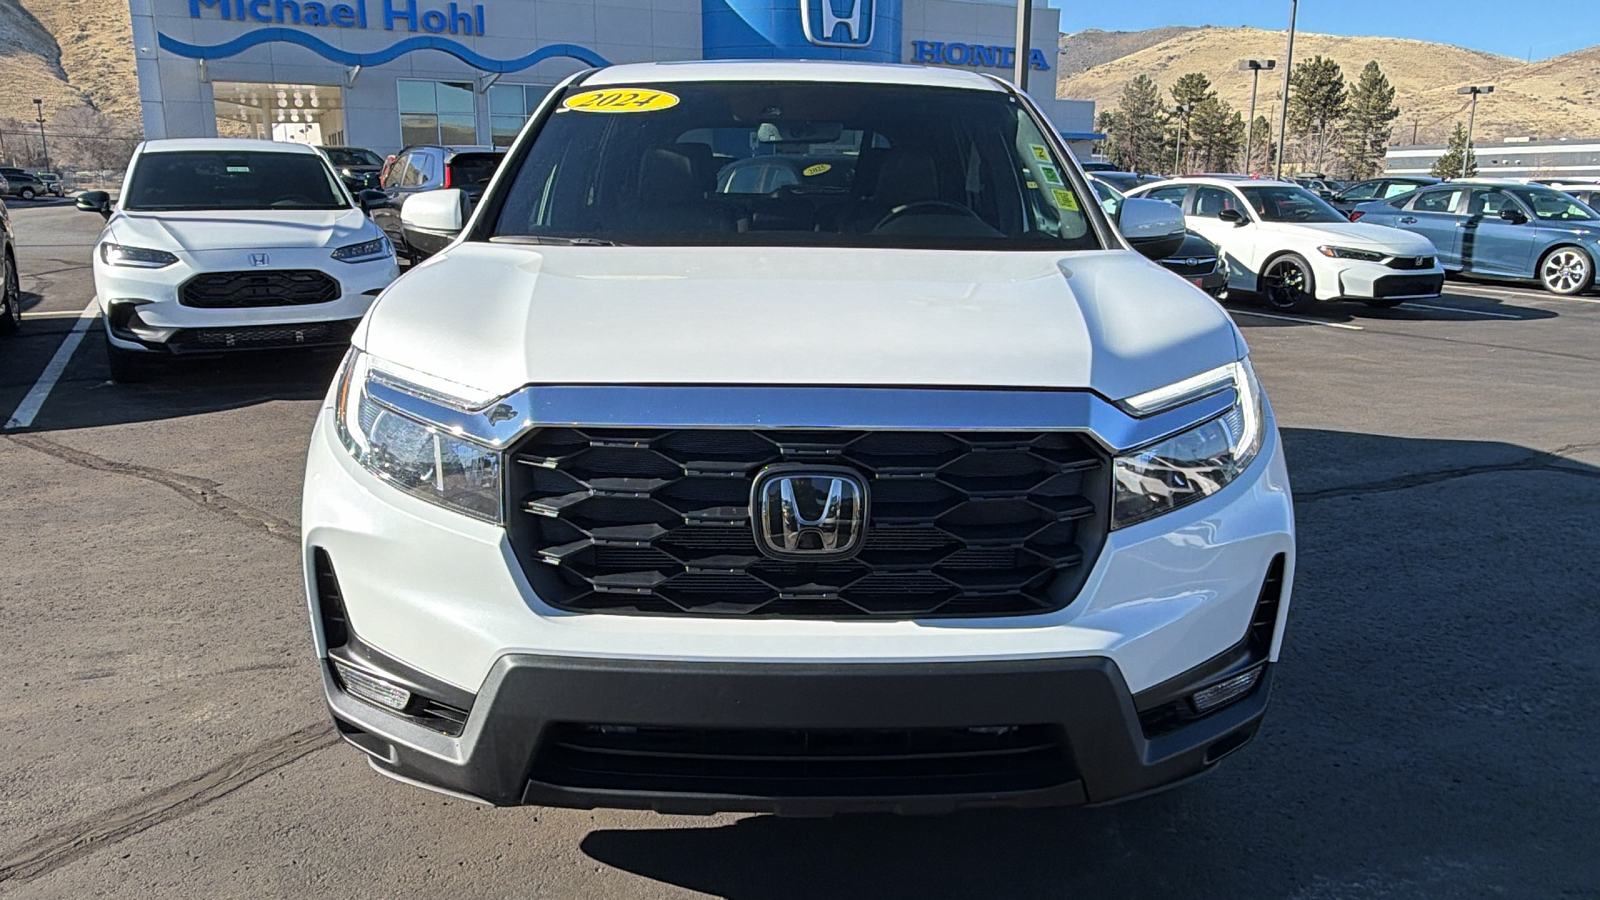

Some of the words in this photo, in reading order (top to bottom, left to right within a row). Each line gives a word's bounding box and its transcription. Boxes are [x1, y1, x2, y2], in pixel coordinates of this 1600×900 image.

[189, 0, 367, 28] Michael
[384, 0, 485, 36] Hohl
[911, 40, 1050, 71] HONDA
[576, 93, 661, 107] 2024
